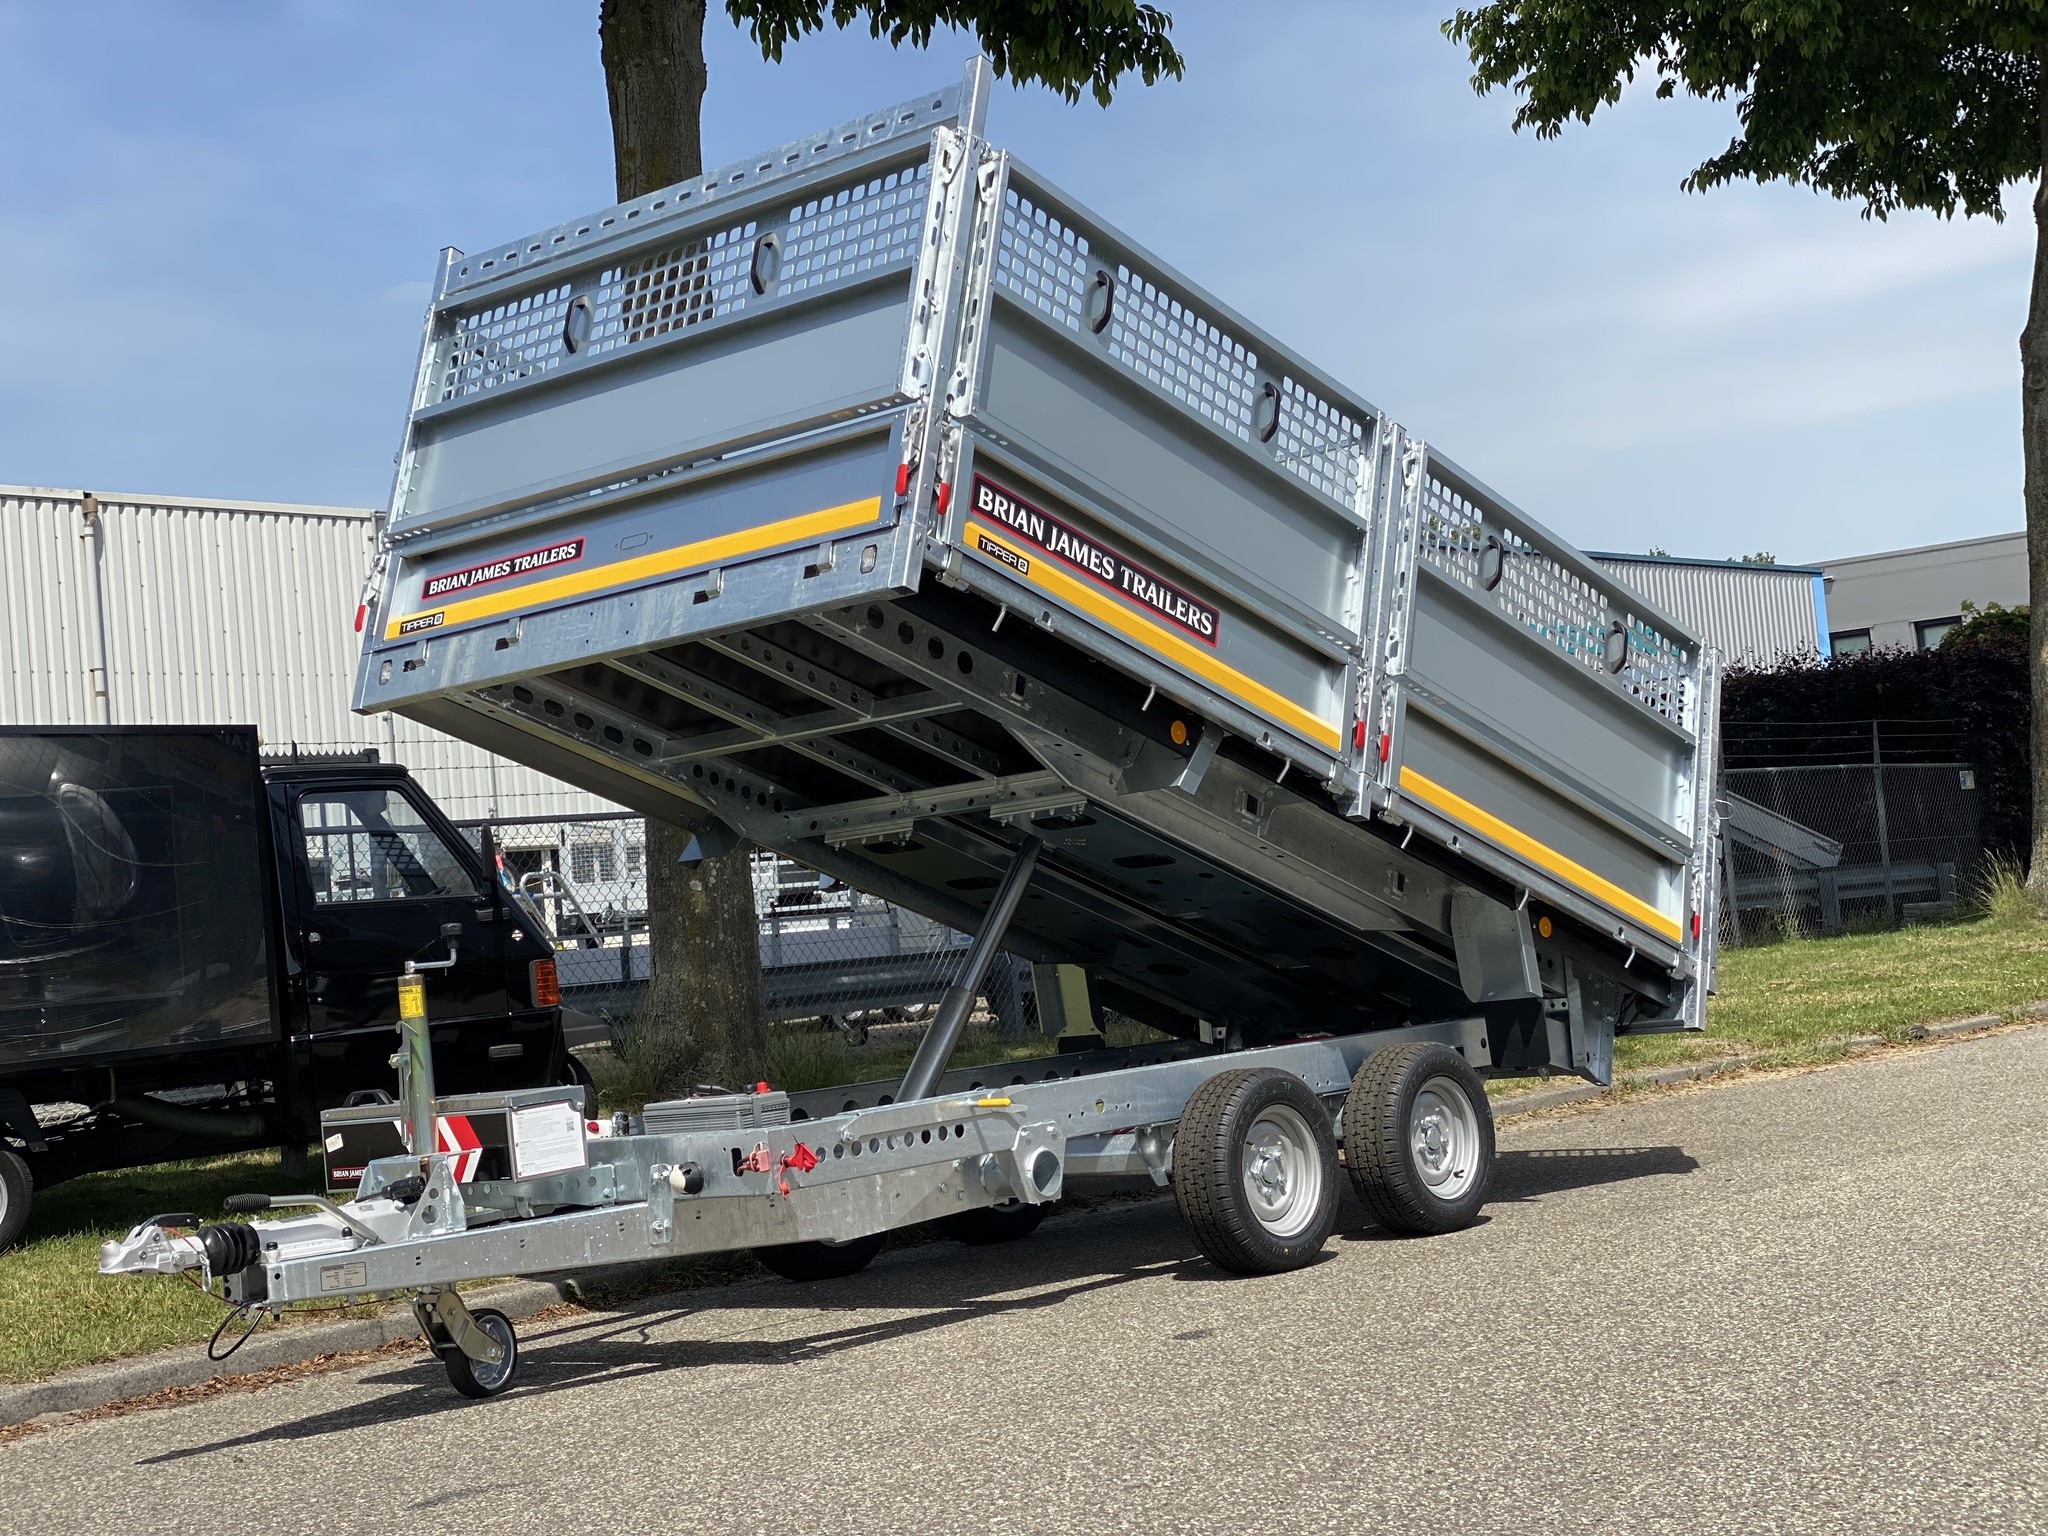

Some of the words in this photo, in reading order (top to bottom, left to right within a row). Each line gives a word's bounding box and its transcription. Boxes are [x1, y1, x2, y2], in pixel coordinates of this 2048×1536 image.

[978, 485, 1045, 541] BRIAN
[1046, 525, 1115, 580] JAMES
[1120, 565, 1213, 636] TRAILERS
[980, 537, 1017, 566] TIPPER
[429, 572, 468, 595] BRIAN
[468, 560, 511, 586] JAMES
[514, 543, 577, 573] TRAILERS
[402, 616, 434, 632] TIPPER
[333, 1170, 349, 1178] BRIAN
